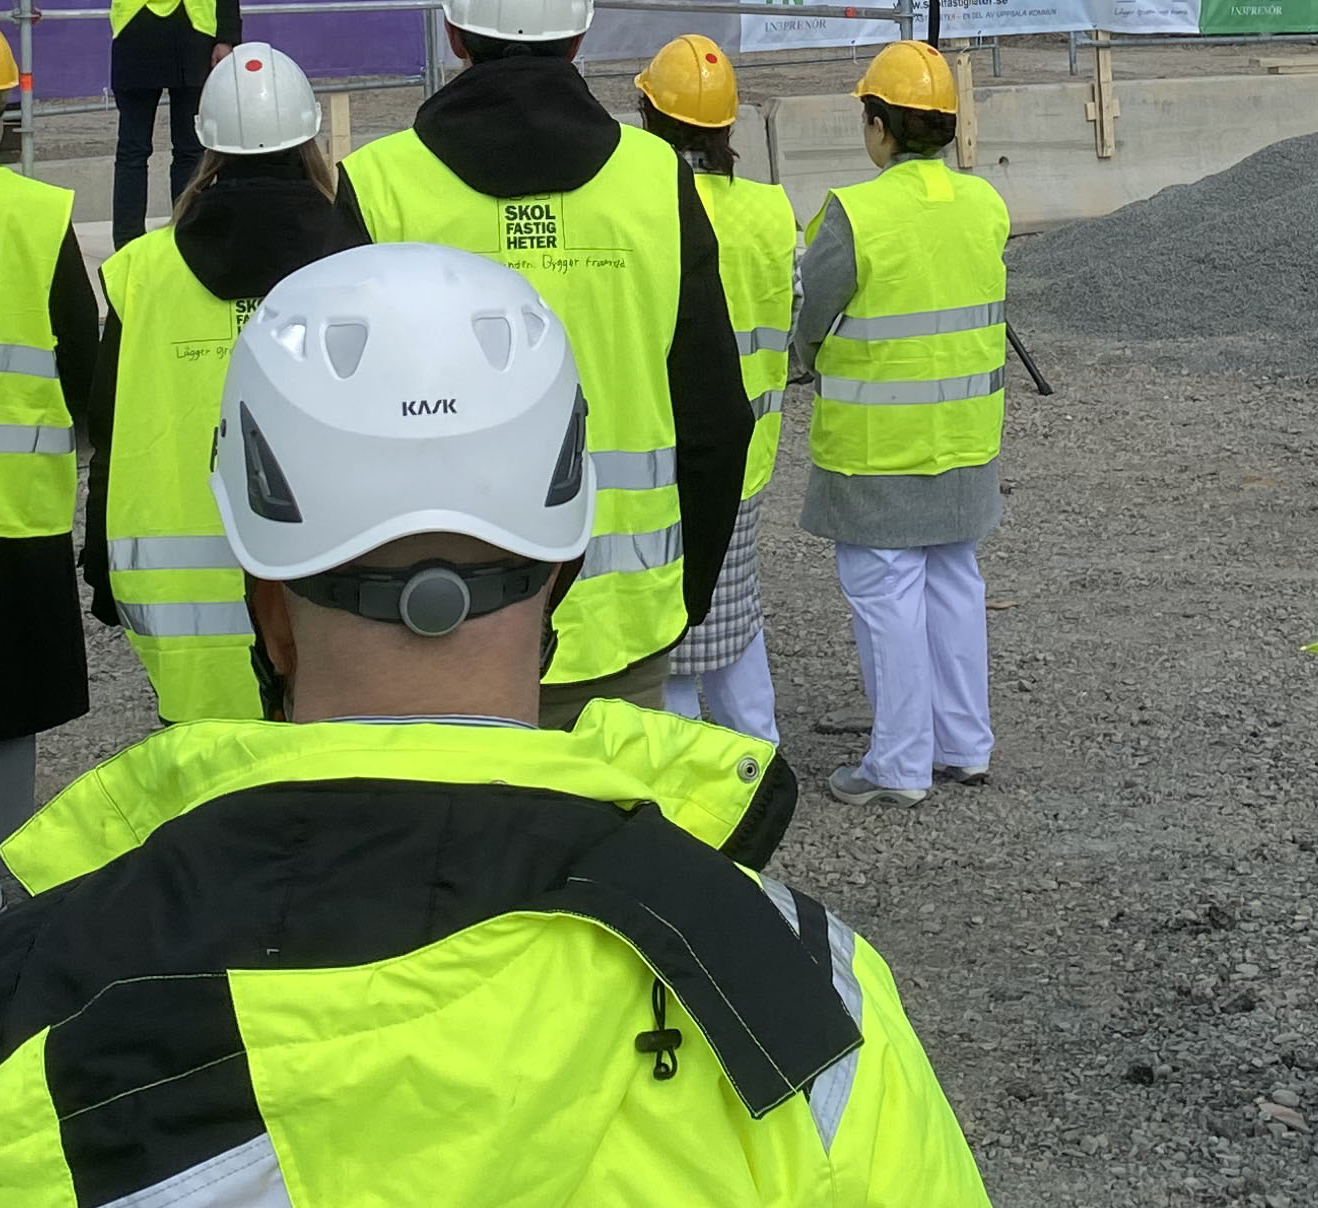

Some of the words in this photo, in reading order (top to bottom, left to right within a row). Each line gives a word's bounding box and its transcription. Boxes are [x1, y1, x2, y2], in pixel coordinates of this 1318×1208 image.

[504, 204, 556, 221] SKOL
[506, 221, 557, 235] FASTIG
[506, 235, 557, 250] HETER
[235, 299, 263, 314] SK
